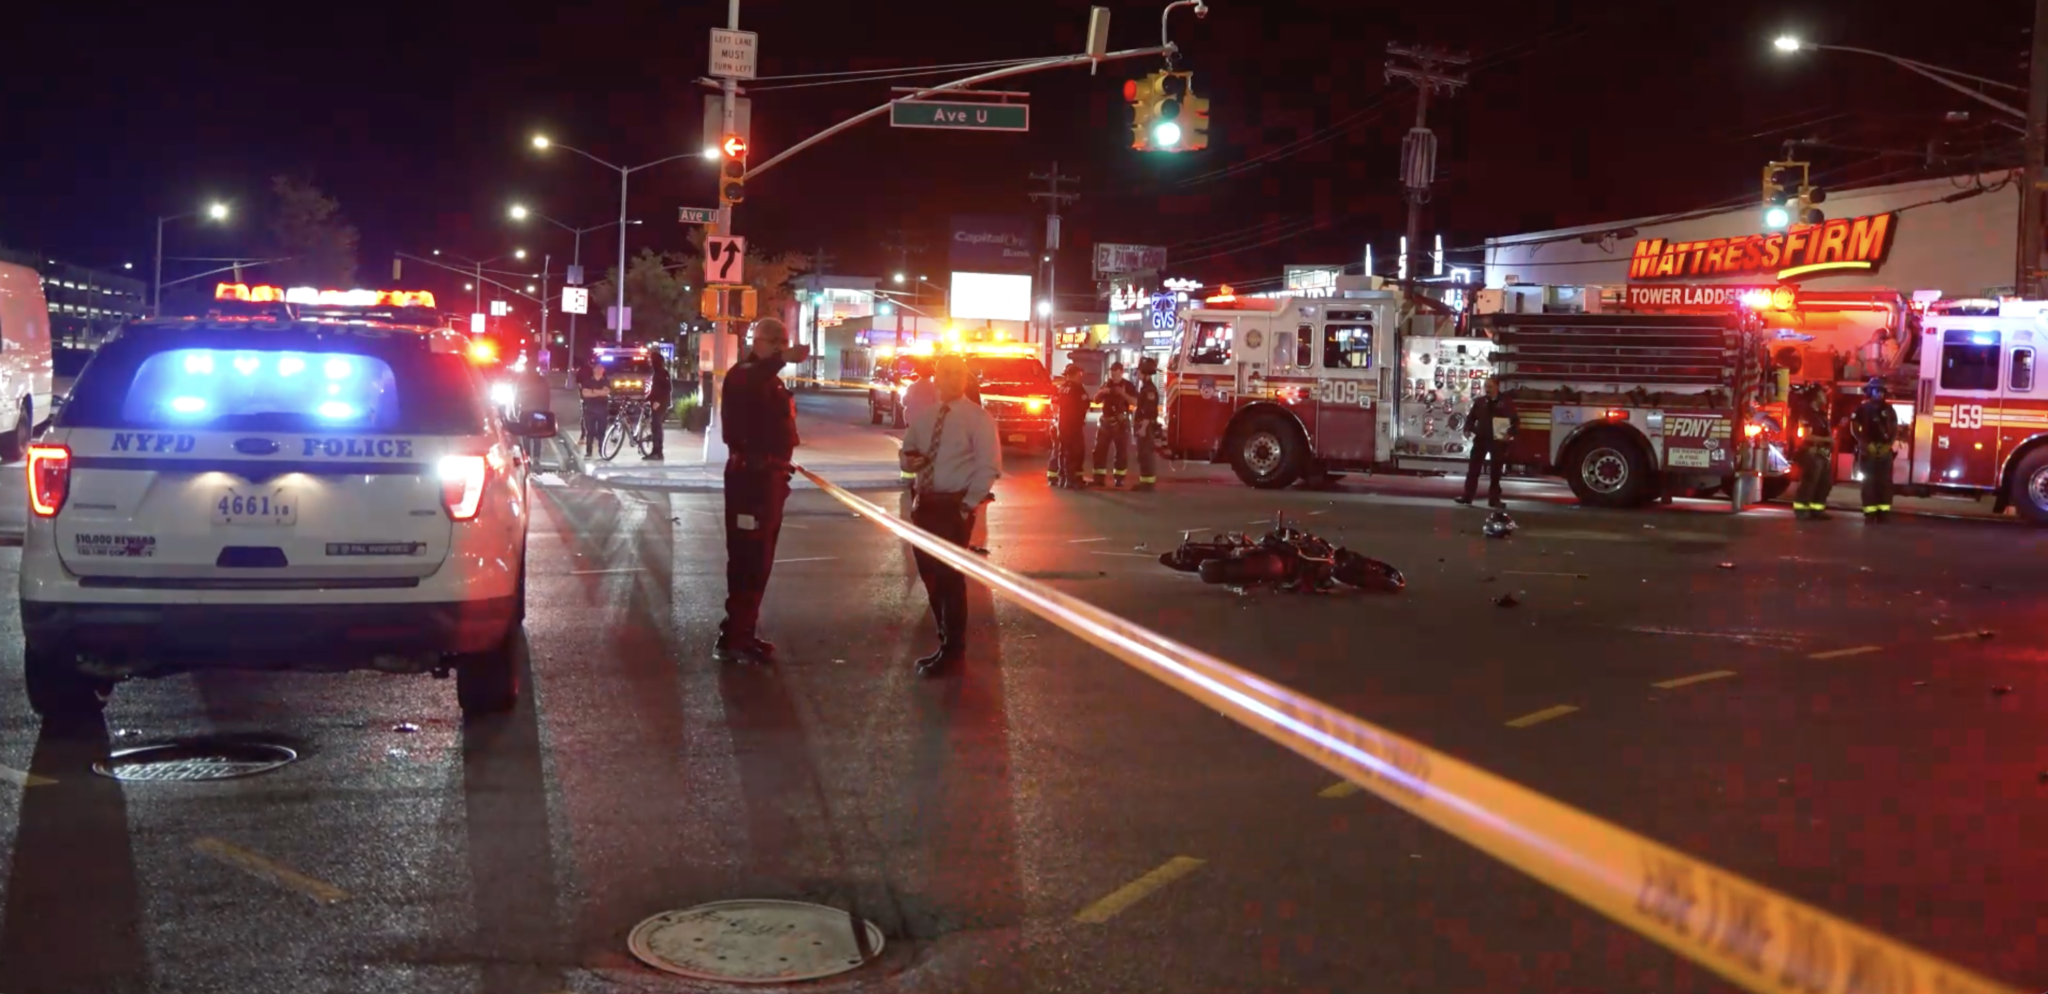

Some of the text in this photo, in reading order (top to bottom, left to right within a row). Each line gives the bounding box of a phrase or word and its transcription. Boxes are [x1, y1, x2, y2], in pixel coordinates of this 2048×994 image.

[714, 35, 752, 47] LEFT LANE
[721, 49, 745, 60] MUST
[714, 62, 752, 73] TURN LEFT
[933, 107, 988, 124] Ave U
[681, 209, 716, 222] Ave U
[1631, 288, 1681, 305] TOWER
[1152, 311, 1175, 329] GVS
[1321, 381, 1358, 403] 309
[1950, 404, 1983, 430] 159
[1672, 418, 1713, 437] FDNY
[111, 433, 413, 458] NYPD POLICE
[218, 495, 270, 516] 4661
[76, 533, 112, 544] $10,000
